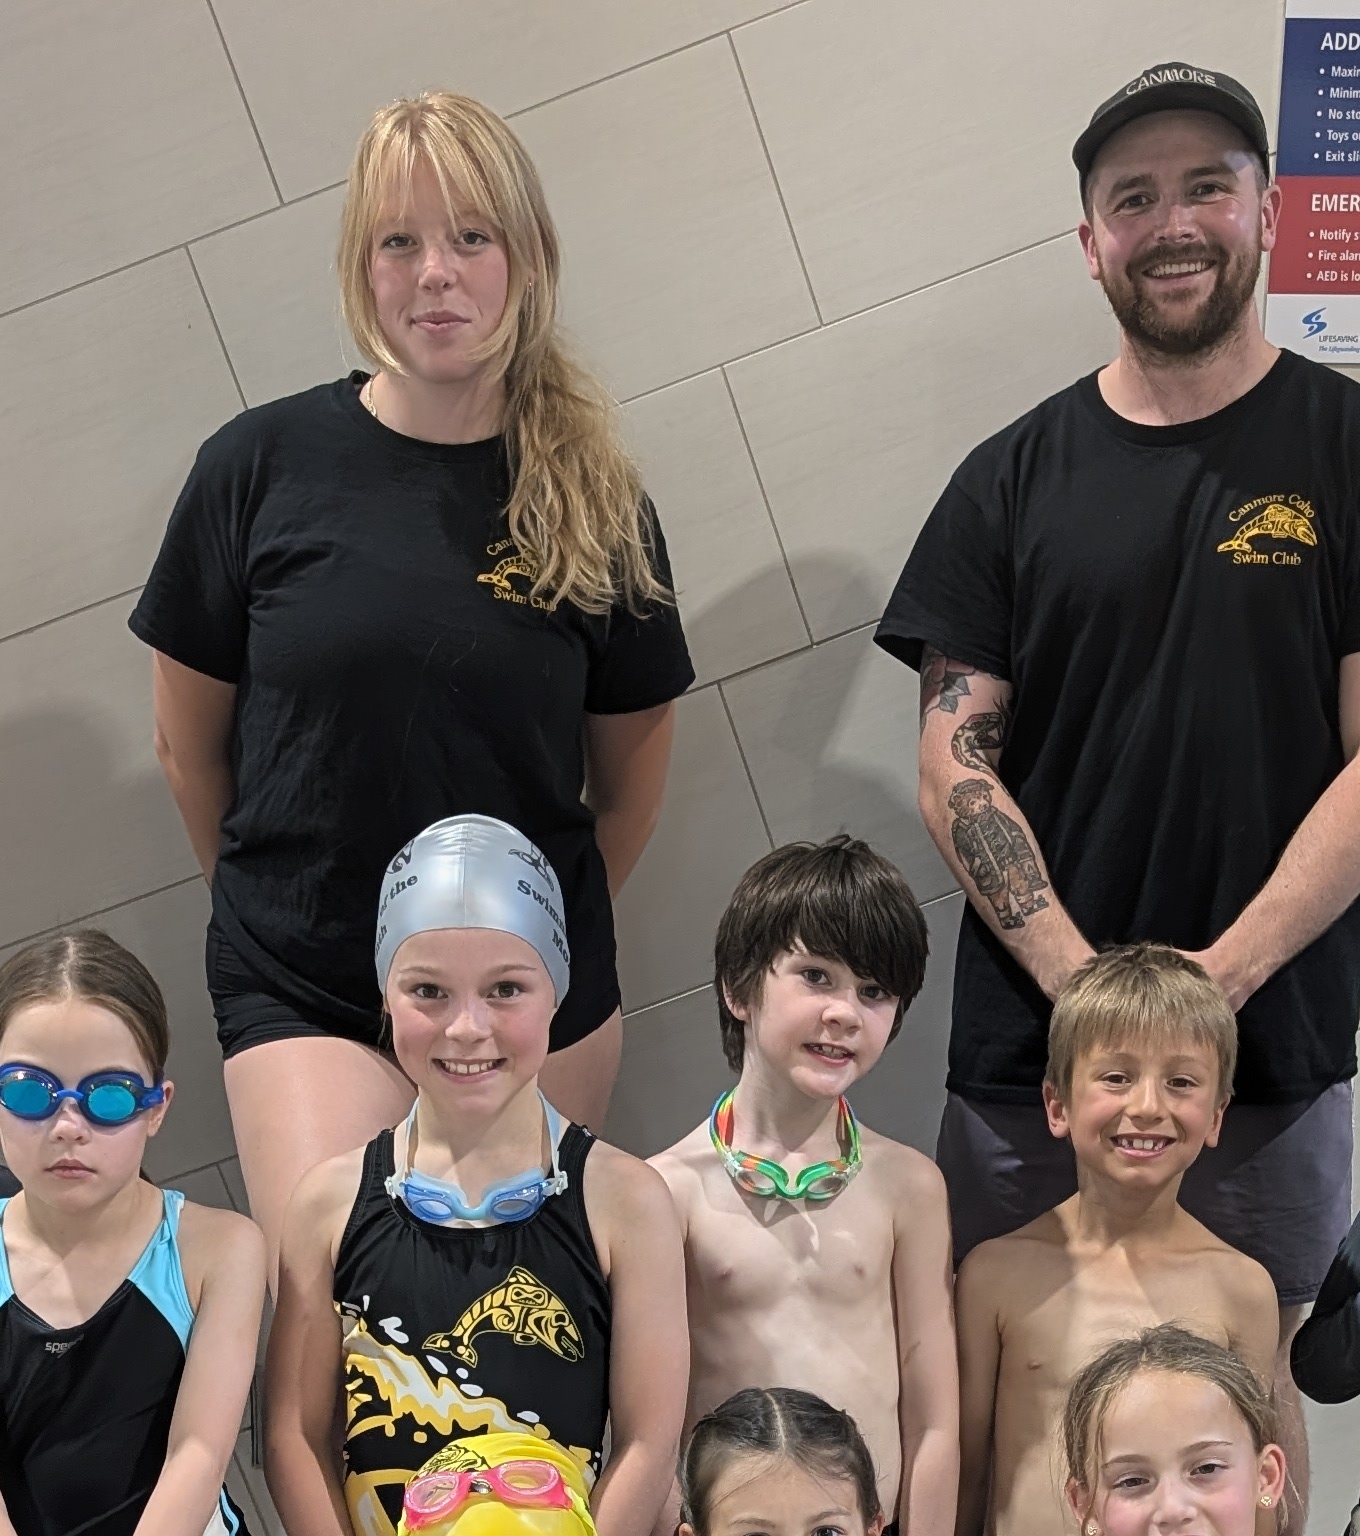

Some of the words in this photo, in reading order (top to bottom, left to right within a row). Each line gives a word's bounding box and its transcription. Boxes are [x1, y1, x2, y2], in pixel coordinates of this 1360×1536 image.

[1126, 68, 1217, 95] CANMORE
[1328, 108, 1344, 120] No
[1326, 129, 1350, 144] Toys
[1325, 150, 1345, 162] Exit
[1319, 228, 1352, 243] Notify
[1318, 249, 1338, 261] Fire
[1316, 270, 1338, 282] AED
[1340, 270, 1349, 282] is
[1228, 494, 1285, 522] Canmore
[1288, 494, 1315, 518] Coho
[1232, 551, 1269, 565] Swim
[1272, 551, 1302, 566] Club
[493, 586, 527, 605] Swim
